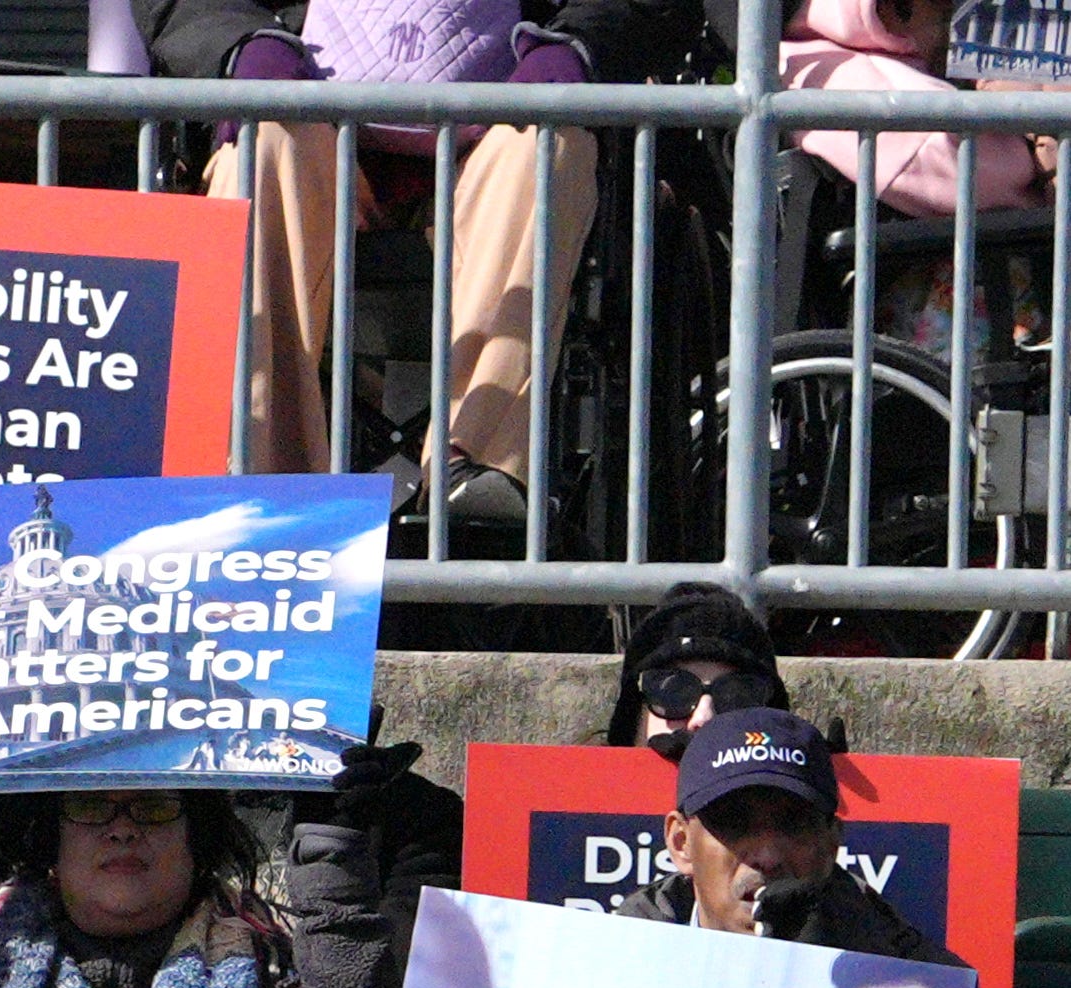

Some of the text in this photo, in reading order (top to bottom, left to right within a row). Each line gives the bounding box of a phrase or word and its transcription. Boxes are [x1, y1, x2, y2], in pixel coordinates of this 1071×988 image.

[26, 338, 139, 391] Are
[15, 549, 332, 591] Congress
[27, 590, 336, 638] Medicaid
[187, 639, 283, 681] for
[711, 744, 806, 769] JAWONIO
[585, 832, 898, 895] Disty
